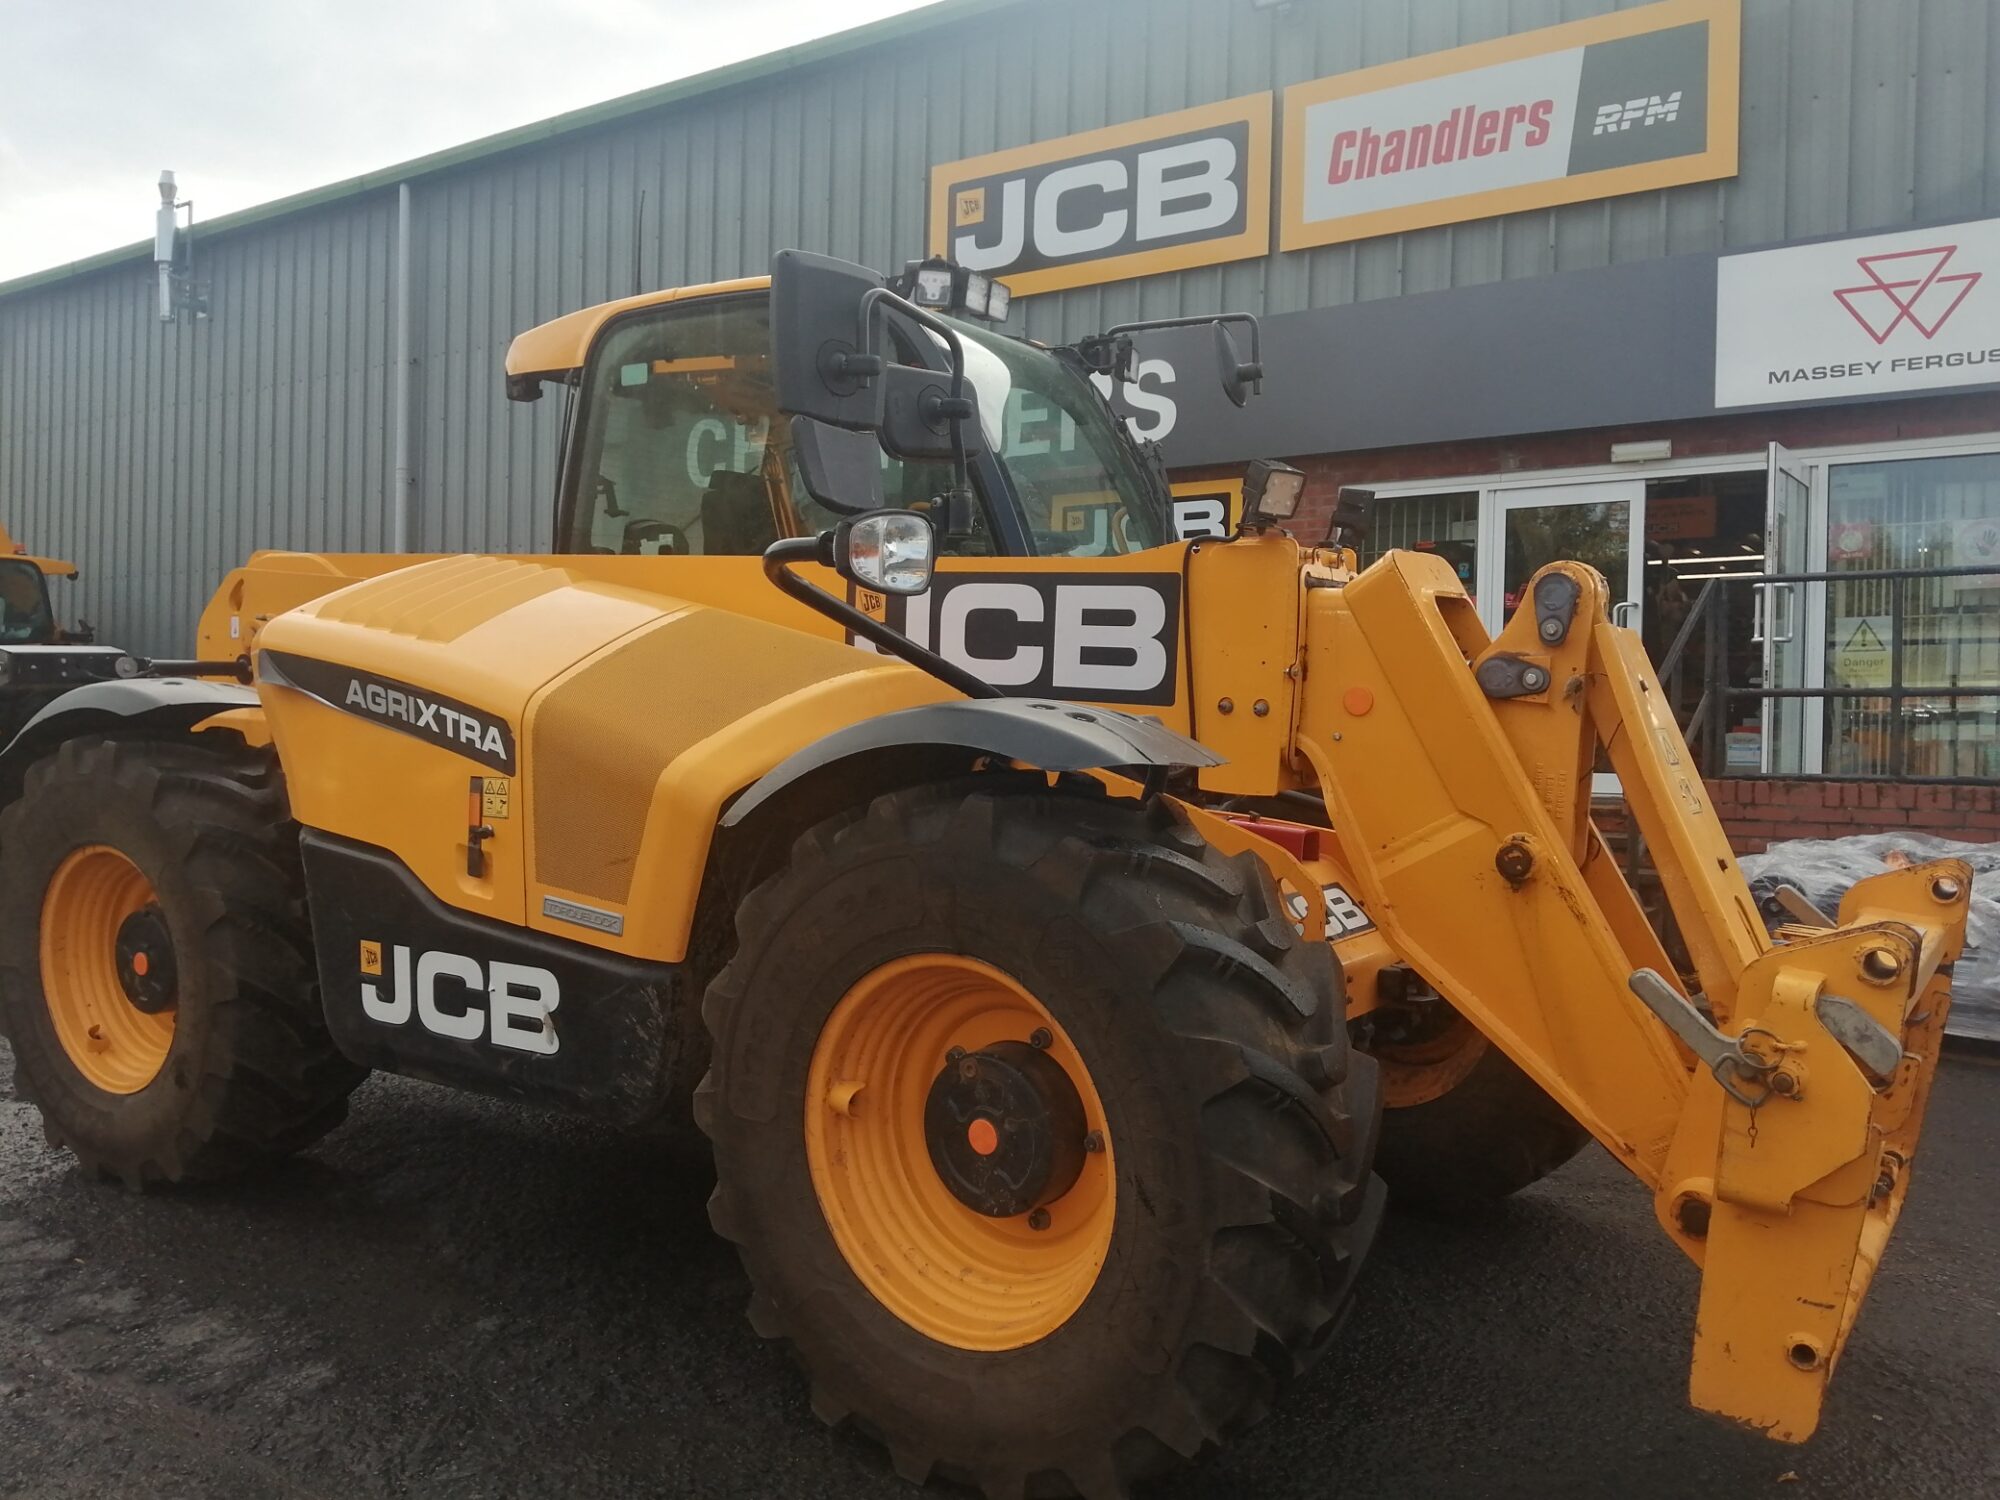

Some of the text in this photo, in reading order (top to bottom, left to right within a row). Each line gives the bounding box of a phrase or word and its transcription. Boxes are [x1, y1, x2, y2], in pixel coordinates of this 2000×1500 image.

[1327, 99, 1554, 185] Chandlers
[1592, 91, 1682, 136] RFM
[955, 138, 1238, 271] JCB
[1768, 361, 1882, 384] MASSEY
[863, 593, 881, 612] JCB
[345, 679, 507, 760] AGRIXTRA
[361, 944, 560, 1055] JCB
